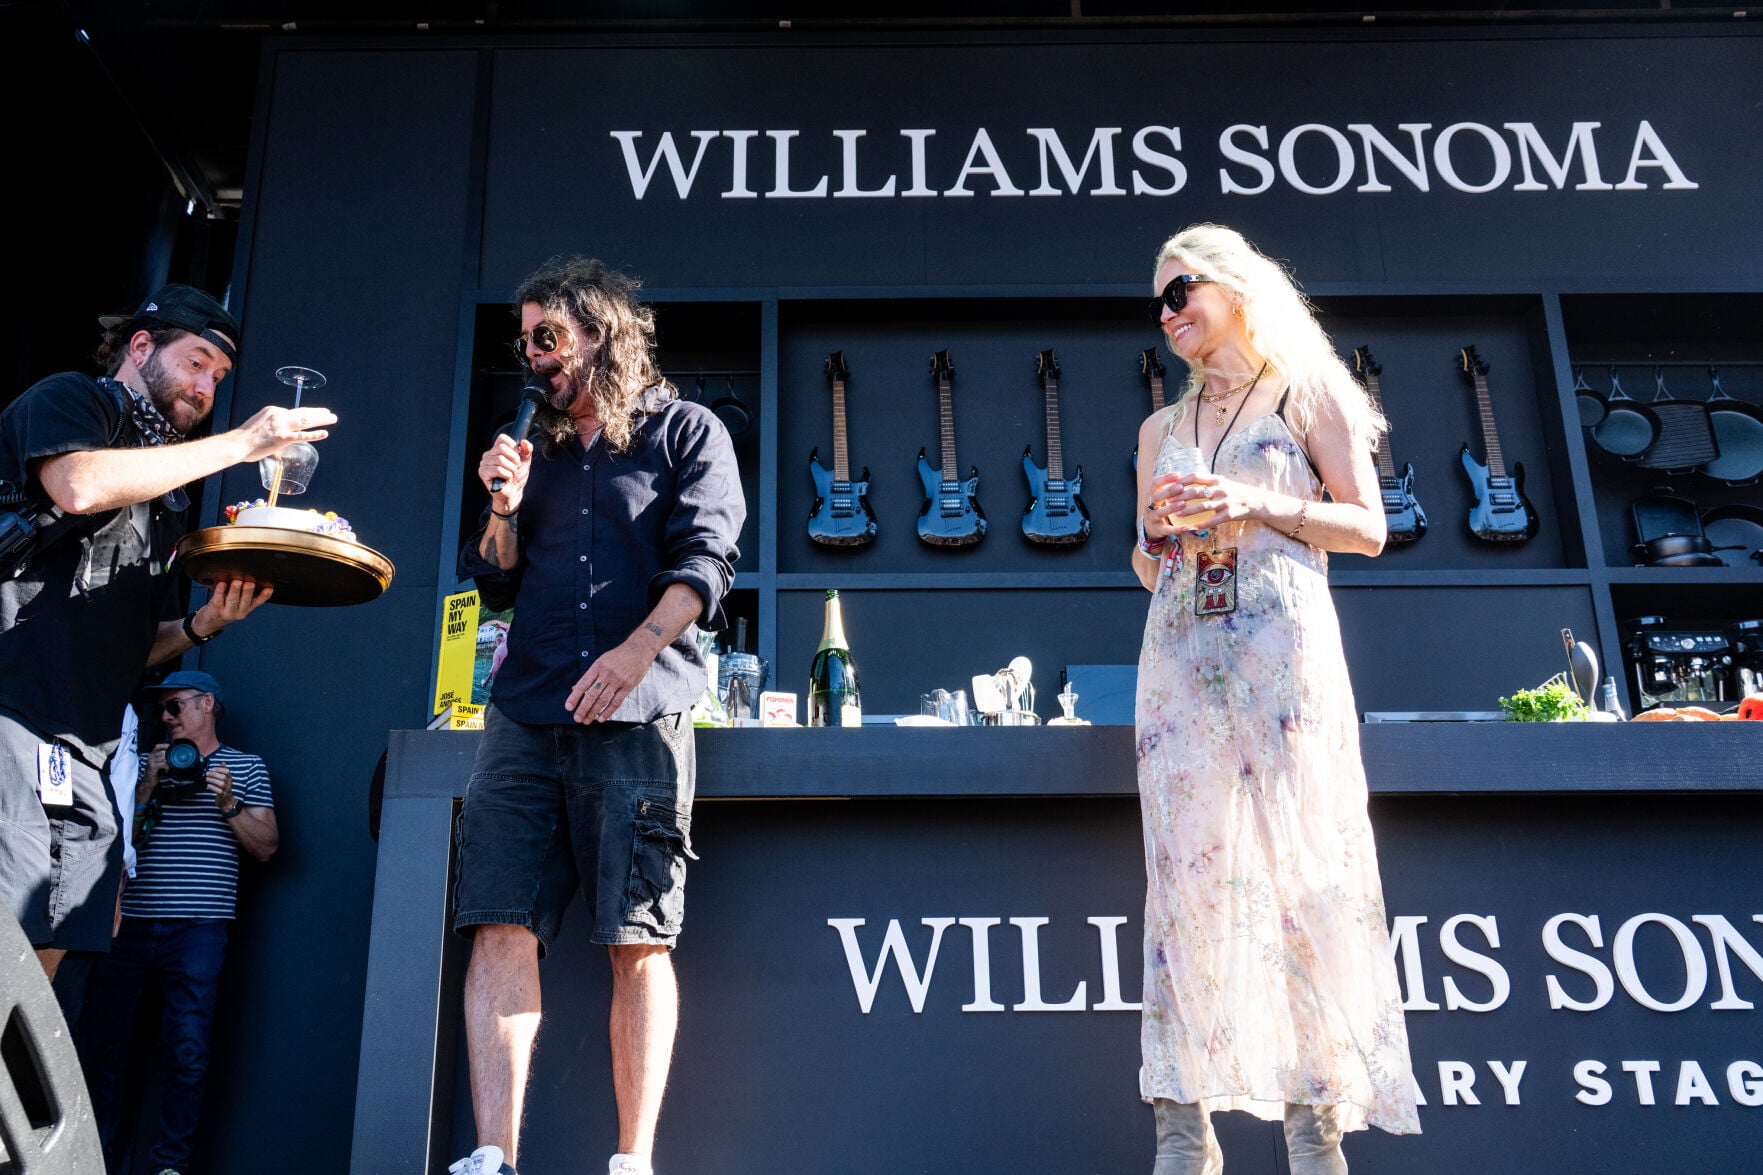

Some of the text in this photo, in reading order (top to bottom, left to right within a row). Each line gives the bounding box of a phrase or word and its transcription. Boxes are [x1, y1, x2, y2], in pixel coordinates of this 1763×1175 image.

[609, 119, 1699, 201] WILLIAMS SONOMA
[449, 594, 476, 611] SPAIN
[448, 609, 464, 623] MY
[447, 620, 468, 635] WAY
[457, 705, 480, 715] SPAIN
